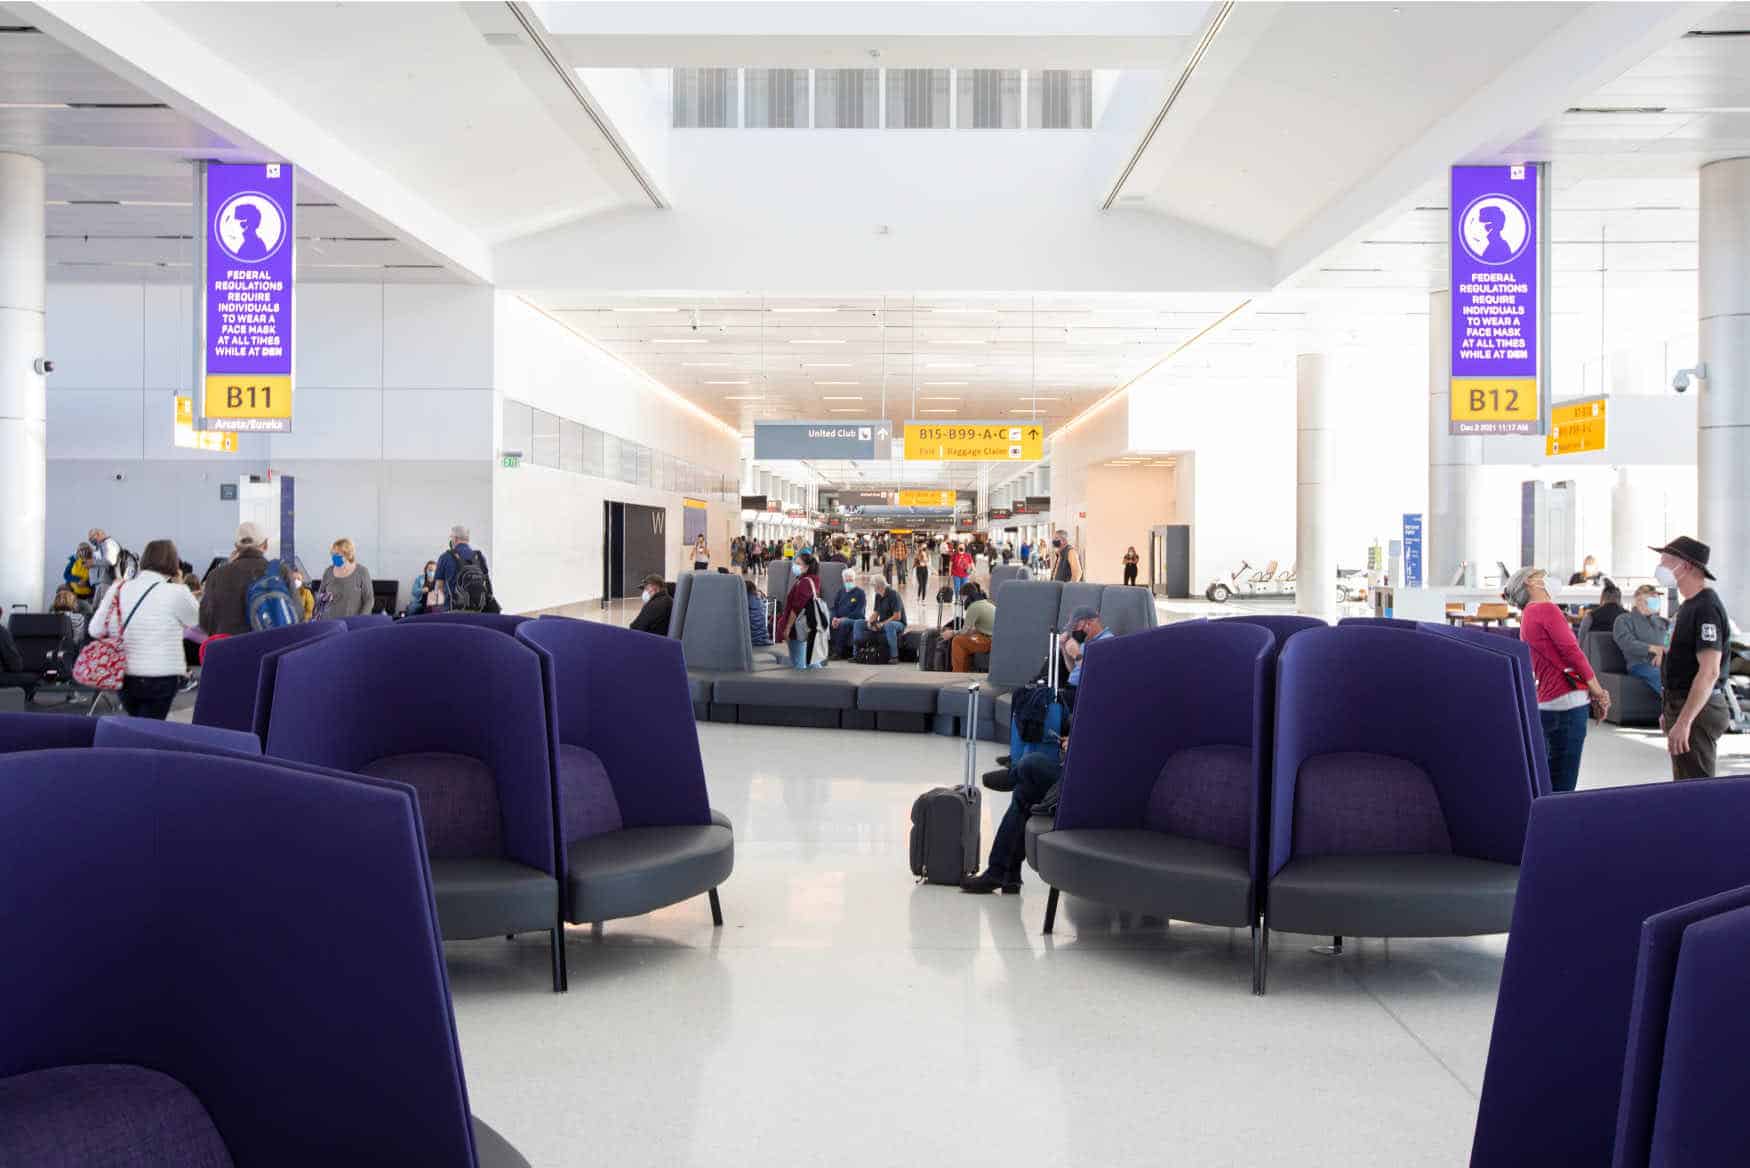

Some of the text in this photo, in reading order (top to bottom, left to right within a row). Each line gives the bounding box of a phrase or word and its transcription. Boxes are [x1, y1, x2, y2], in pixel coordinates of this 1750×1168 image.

[227, 270, 271, 280] FEDERAL
[1472, 273, 1516, 282] FEDERAL
[215, 281, 283, 290] REGULATIONS
[1460, 284, 1528, 293] REGULATIONS
[228, 292, 270, 301] REQUIRE
[1472, 295, 1515, 304] REQUIRE
[218, 303, 280, 312] INDIVIDUALS
[1462, 306, 1525, 315] INDIVIDUALS
[222, 314, 275, 323] TO WEAR A
[1467, 317, 1520, 326] TO WEAR A
[222, 324, 276, 334] FACE MASK
[1466, 328, 1521, 336] FACE MASK
[218, 336, 280, 345] AT ALL TIMES
[1462, 338, 1526, 348] AT ALL TIMES
[215, 346, 246, 356] WHILE
[248, 346, 260, 356] AT
[1460, 350, 1492, 359] WHILE
[1493, 350, 1506, 359] AT
[227, 386, 271, 408] B11
[1470, 389, 1520, 411] B12
[1516, 424, 1528, 432] AM
[808, 428, 856, 438] United Club
[651, 511, 664, 536] W
